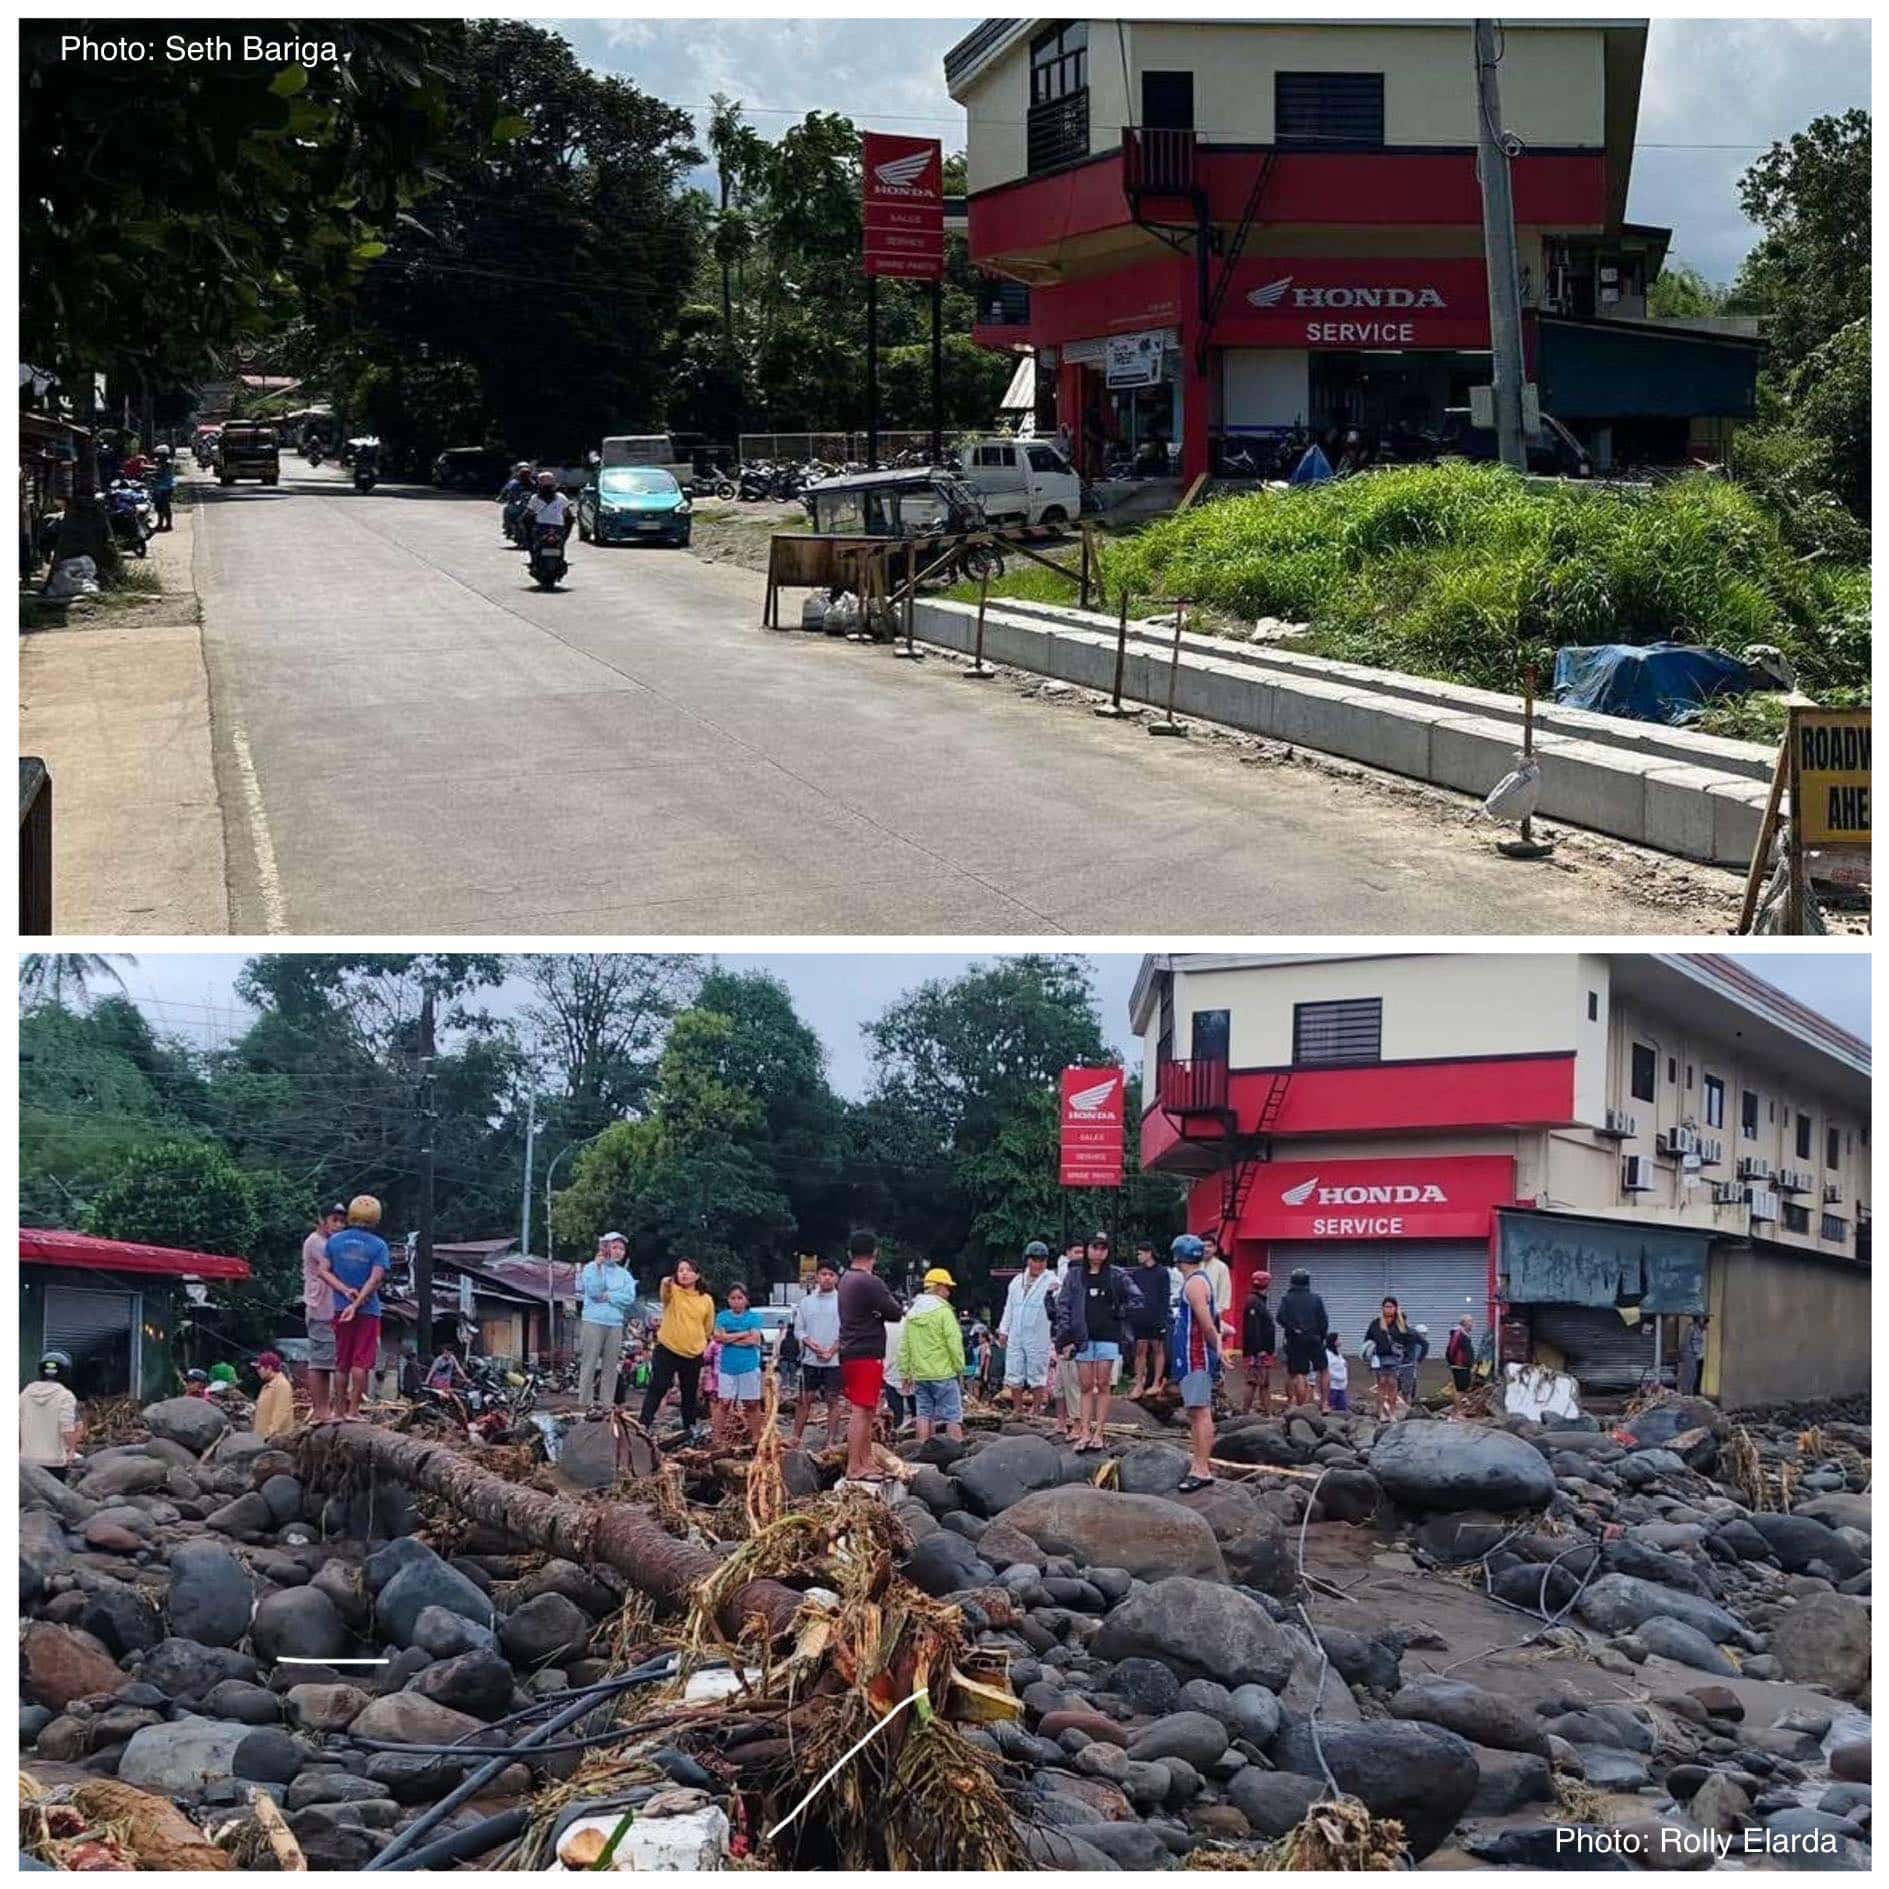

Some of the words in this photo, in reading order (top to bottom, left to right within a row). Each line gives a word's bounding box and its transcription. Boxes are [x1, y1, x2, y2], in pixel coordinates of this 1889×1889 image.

[875, 185, 936, 198] HONDA
[1294, 287, 1447, 308] HONDA
[1306, 322, 1414, 342] SERVICE
[1829, 786, 1872, 830] AHE
[1068, 1110, 1116, 1120] HONDA
[1318, 1184, 1449, 1205] HONDA
[1313, 1217, 1403, 1235] SERVICE
